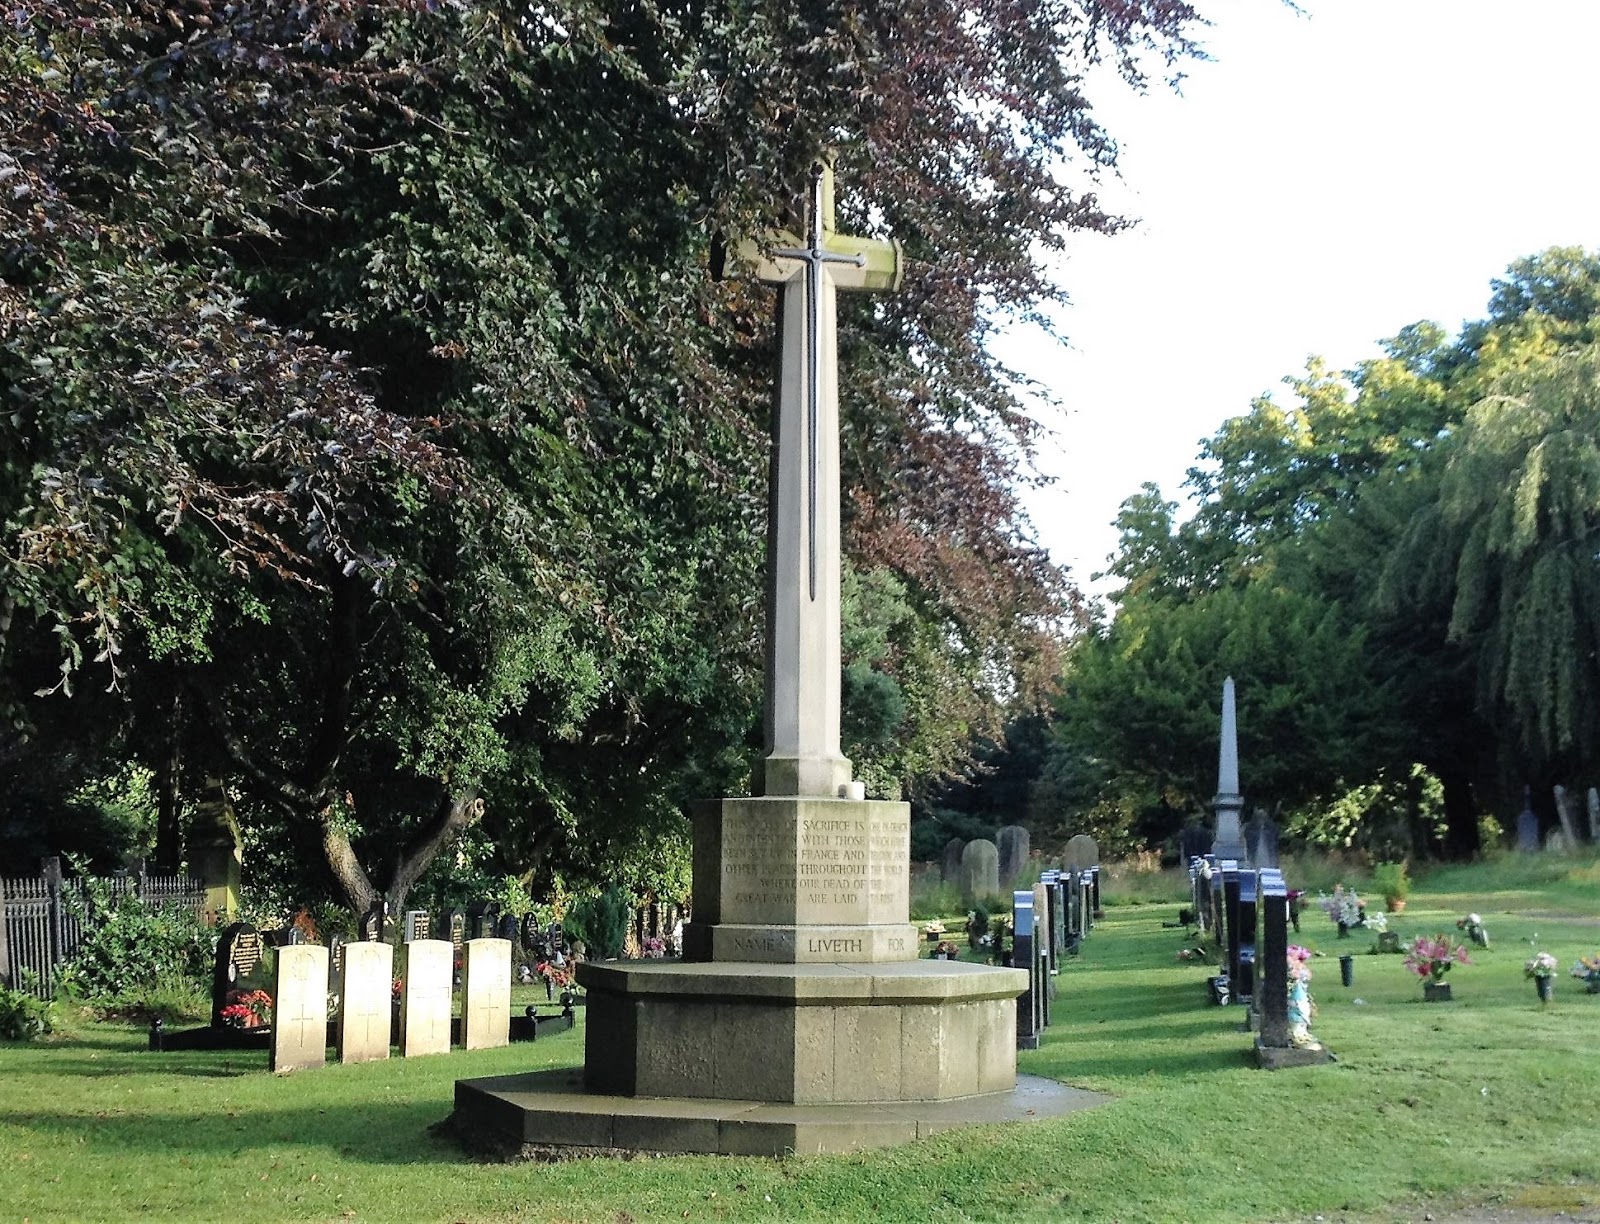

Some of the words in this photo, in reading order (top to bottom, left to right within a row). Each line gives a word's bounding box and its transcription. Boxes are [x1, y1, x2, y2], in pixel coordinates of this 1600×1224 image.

[803, 819, 850, 831] SACRIFICE
[855, 821, 865, 832] IS
[801, 834, 830, 846] WITH
[835, 835, 865, 846] THOSE
[801, 849, 839, 860] FRANCE
[843, 850, 865, 860] AND
[799, 863, 868, 875] THROUGHOUT
[799, 878, 821, 889] OUR
[823, 879, 850, 889] DEAD
[853, 879, 867, 889] OF
[808, 893, 828, 904] ARE
[834, 893, 857, 904] LAID
[733, 937, 775, 953] NAME
[808, 938, 863, 954] LIVETH
[887, 937, 905, 952] FOR
